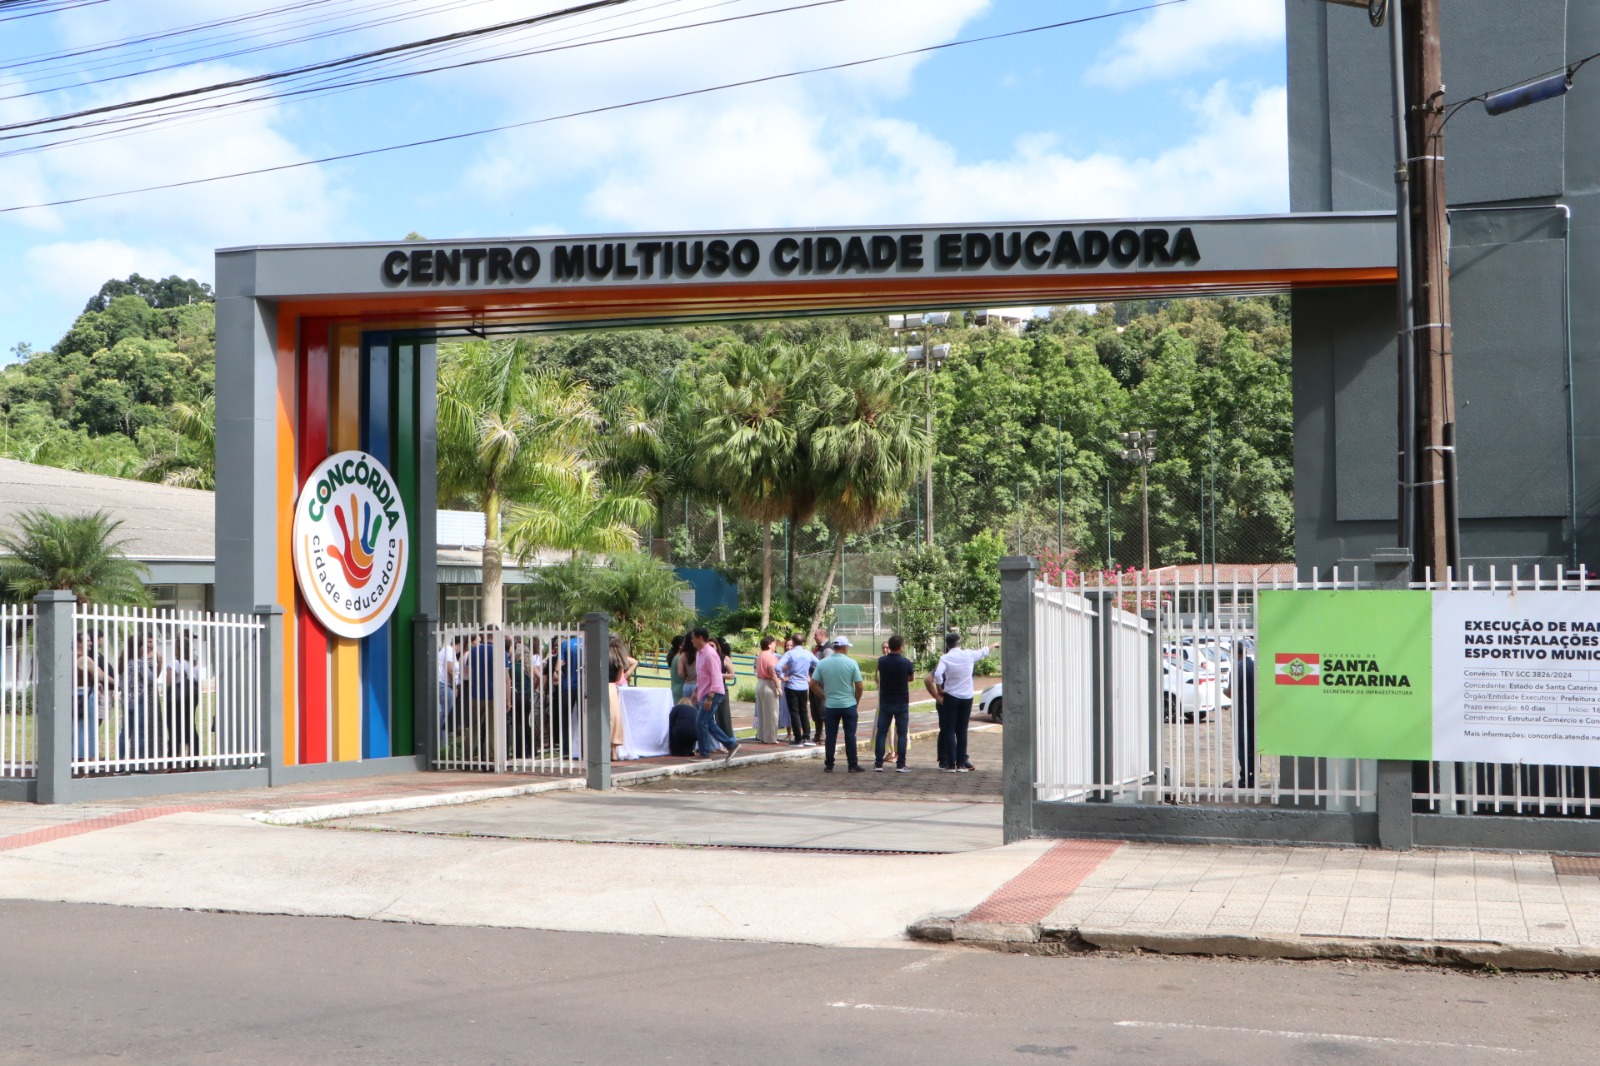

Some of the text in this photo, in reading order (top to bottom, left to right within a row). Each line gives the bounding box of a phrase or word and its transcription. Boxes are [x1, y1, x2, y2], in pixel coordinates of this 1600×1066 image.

[383, 227, 1201, 285] CENTRO MULTIUSO CIDADE EDUCADORA
[308, 454, 400, 532] CONCÓRDIA
[312, 535, 396, 612] cidade educadora
[1464, 618, 1544, 634] EXECUÇÃO
[1547, 621, 1567, 632] DE
[1464, 633, 1599, 649] NAS INSTALAÇÕES
[1464, 648, 1547, 660] ESPORTIVO
[1323, 659, 1380, 672] SANTA
[1322, 673, 1411, 687] CATARINA
[1509, 682, 1533, 690] Estado
[1464, 692, 1519, 701] Órgão/Entidade
[1521, 693, 1557, 701] Executora:
[1484, 704, 1519, 712] execução:
[1482, 731, 1526, 739] informações:
